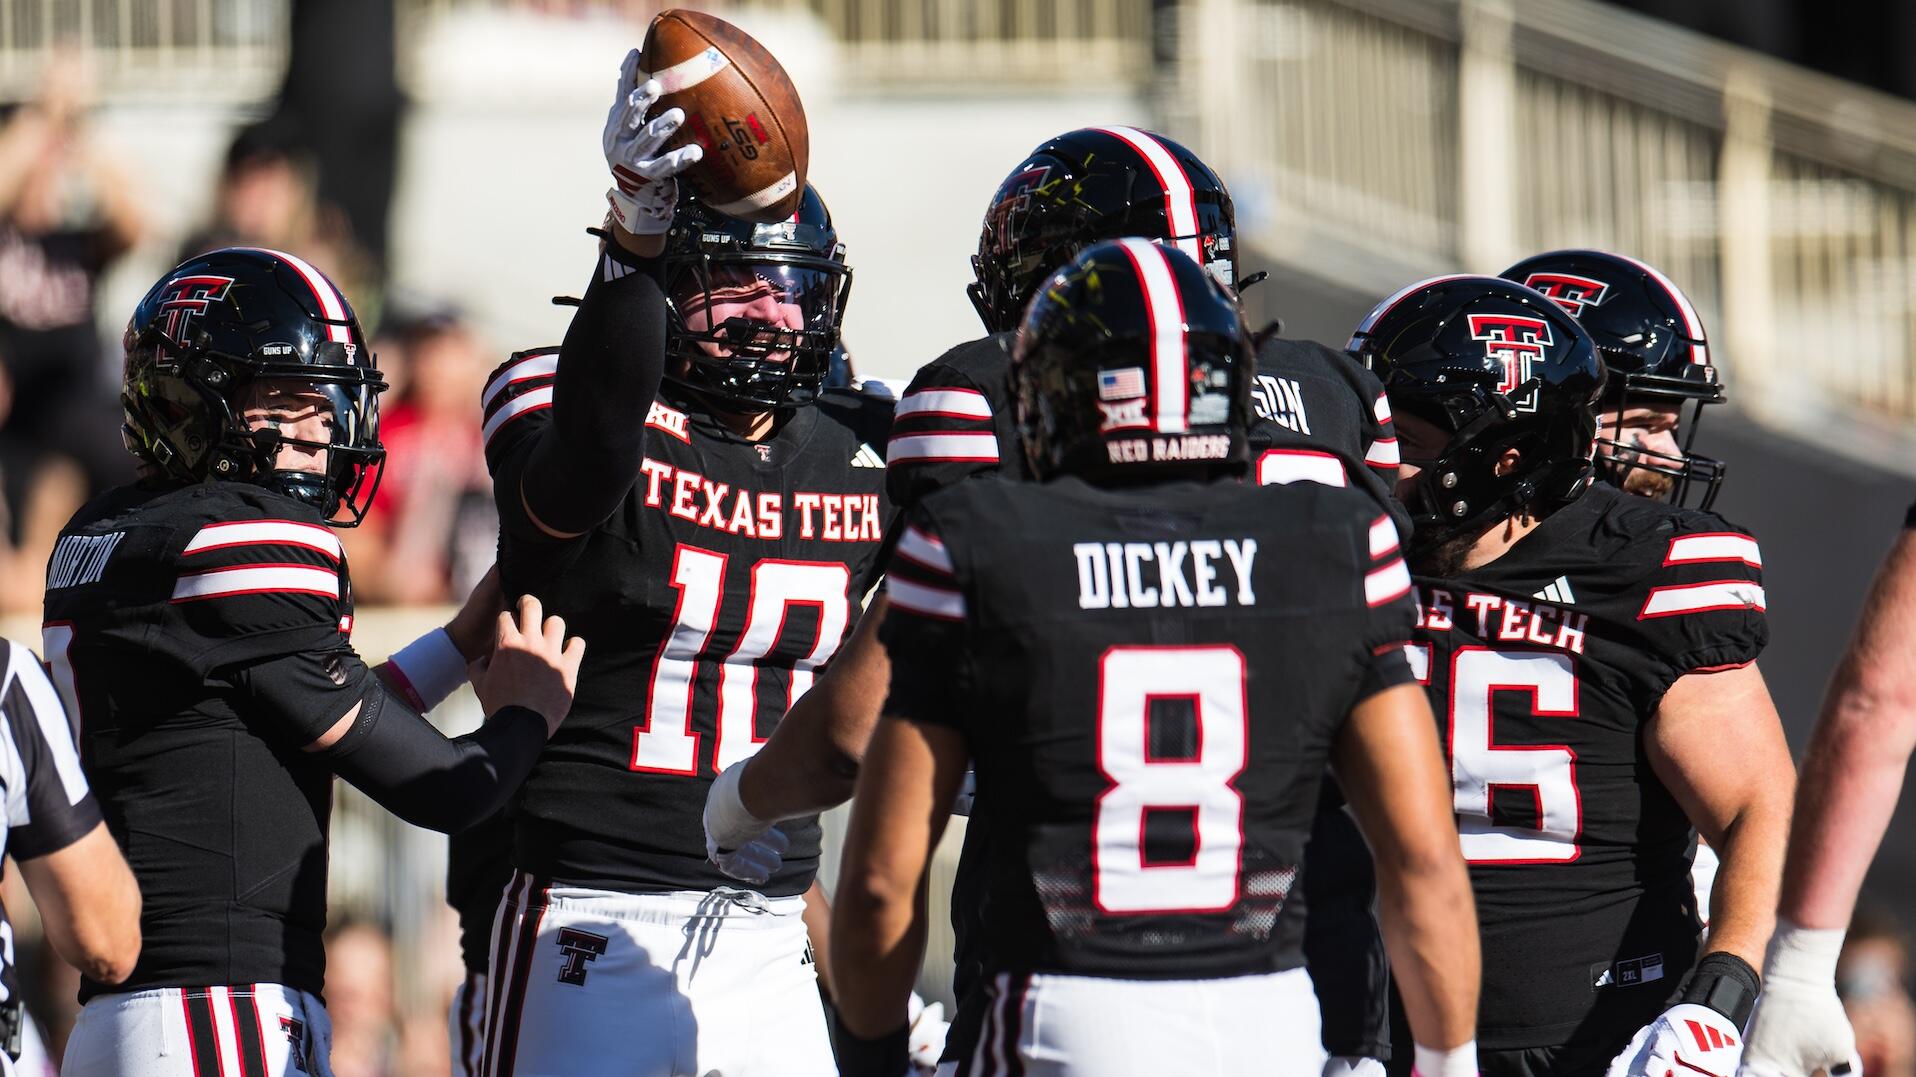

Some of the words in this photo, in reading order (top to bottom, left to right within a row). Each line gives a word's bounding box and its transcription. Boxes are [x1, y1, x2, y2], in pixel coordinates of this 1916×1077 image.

[702, 233, 720, 243] GUNS
[720, 234, 731, 244] UP
[263, 347, 282, 356] GUNS
[282, 346, 292, 355] UP
[1106, 438, 1149, 464] RED
[1151, 434, 1231, 462] RAIDERS
[639, 456, 783, 541] TEXAS
[793, 491, 883, 542] TECH
[1072, 537, 1258, 609] DICKEY
[629, 541, 851, 777] 10
[1465, 591, 1590, 656] TECH
[1093, 643, 1249, 916] 8
[1402, 639, 1583, 865] 6
